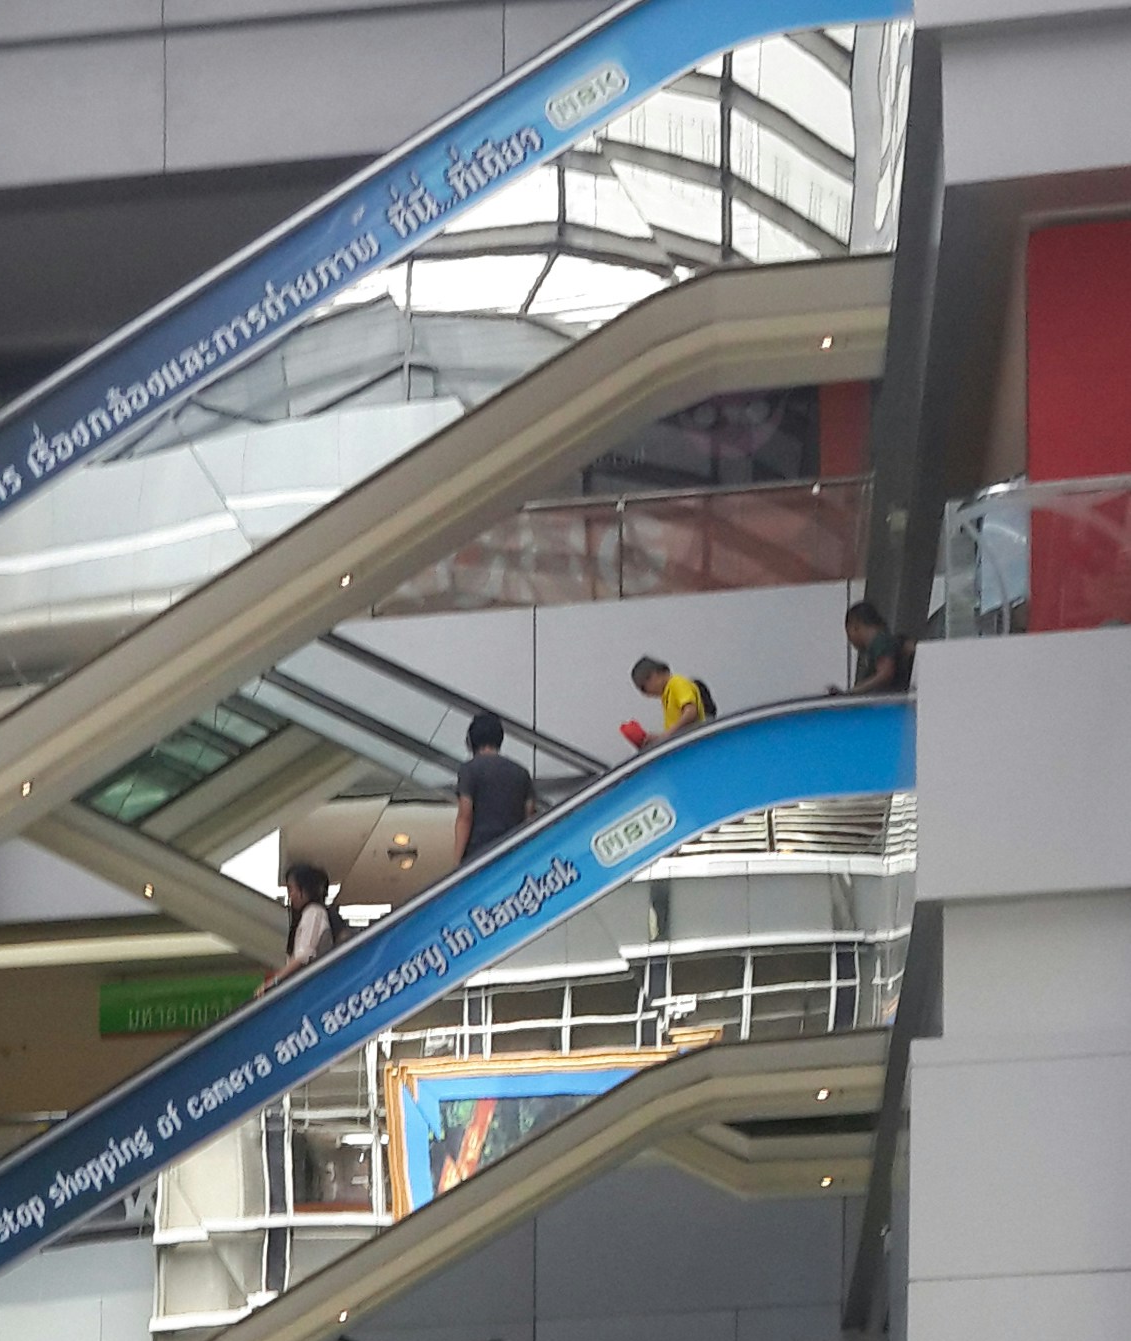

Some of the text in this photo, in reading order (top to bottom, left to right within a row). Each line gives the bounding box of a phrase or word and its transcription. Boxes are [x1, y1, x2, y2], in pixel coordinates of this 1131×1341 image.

[48, 1126, 155, 1209] shopping
[156, 1100, 183, 1140] of
[186, 1053, 273, 1120] camera
[273, 1015, 320, 1065] and
[320, 944, 447, 1036] accessory
[441, 924, 477, 957] in
[469, 856, 582, 938] Bangkok
